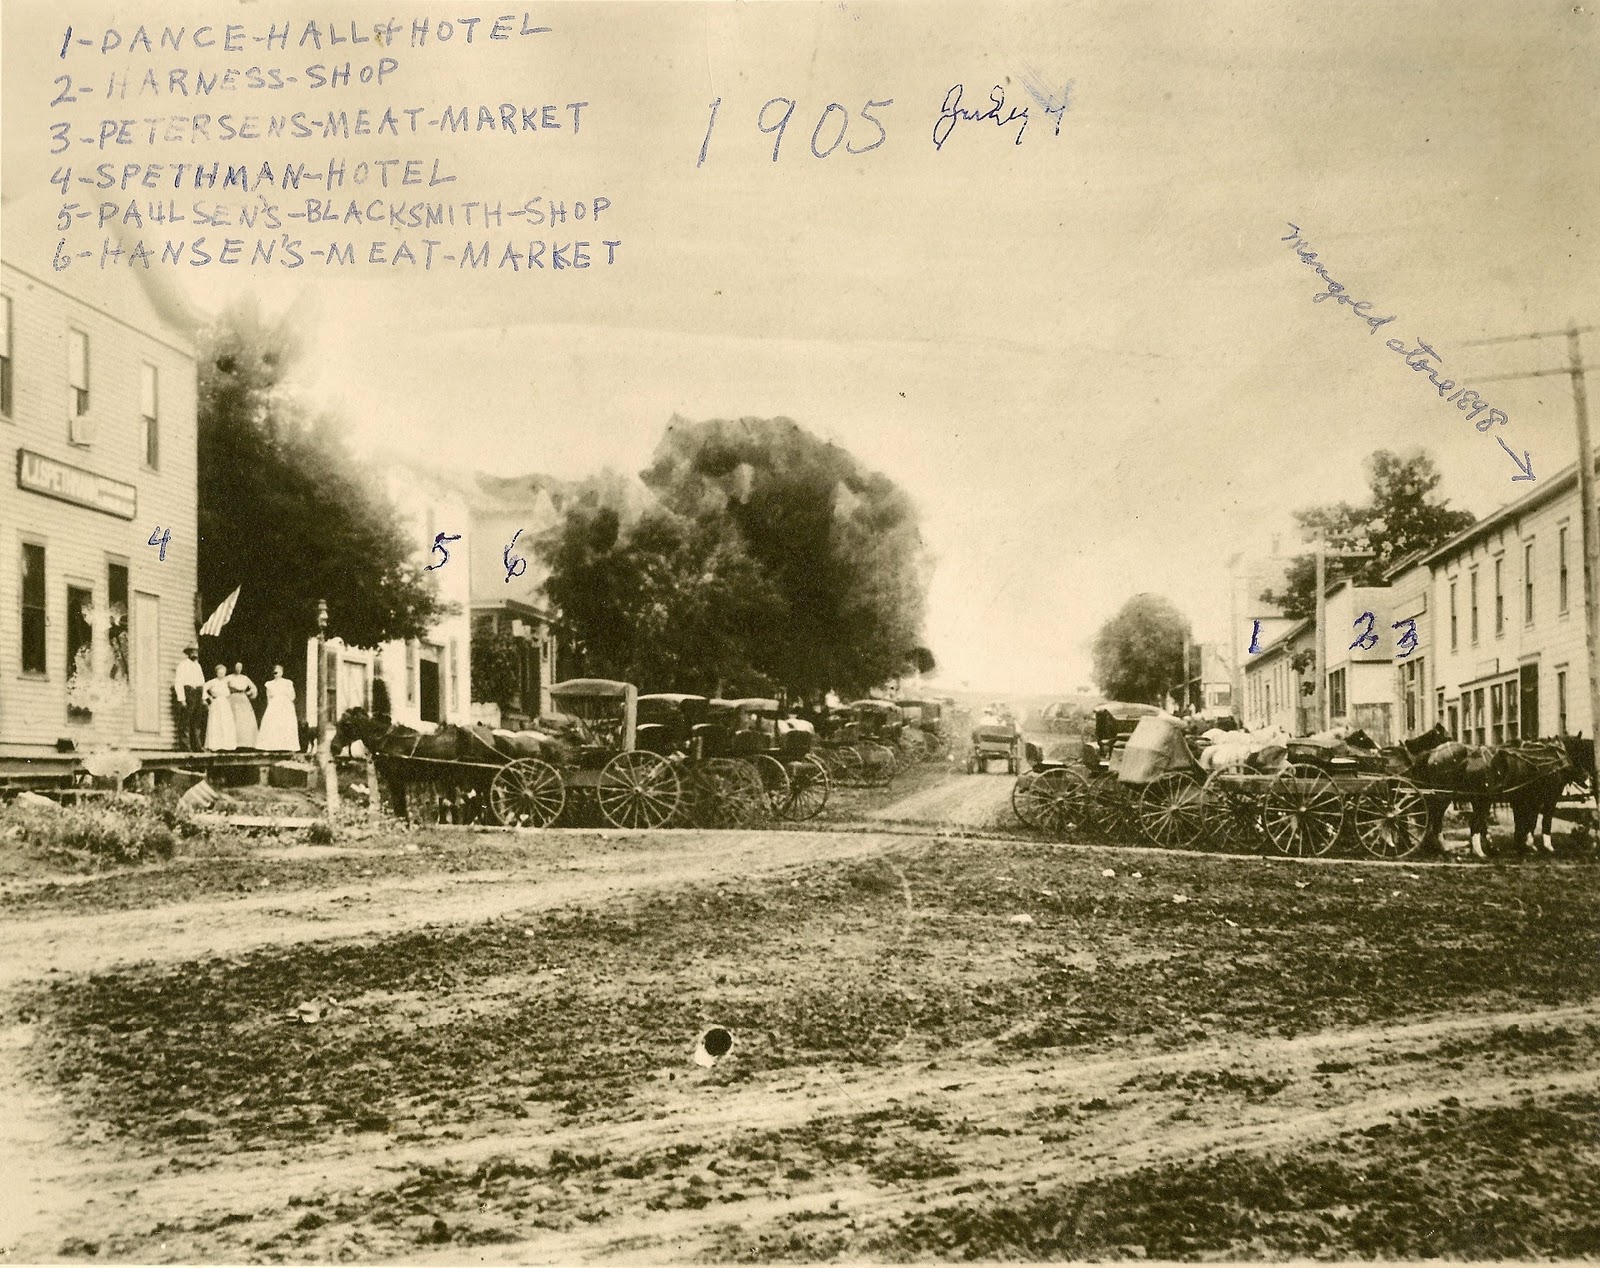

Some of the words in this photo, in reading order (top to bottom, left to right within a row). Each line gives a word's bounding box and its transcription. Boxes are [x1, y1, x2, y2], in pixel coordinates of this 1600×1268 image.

[697, 97, 894, 168] 1905
[147, 525, 172, 562] 4
[423, 531, 462, 571] 5
[503, 528, 527, 584] 6
[1248, 618, 1262, 654] 1
